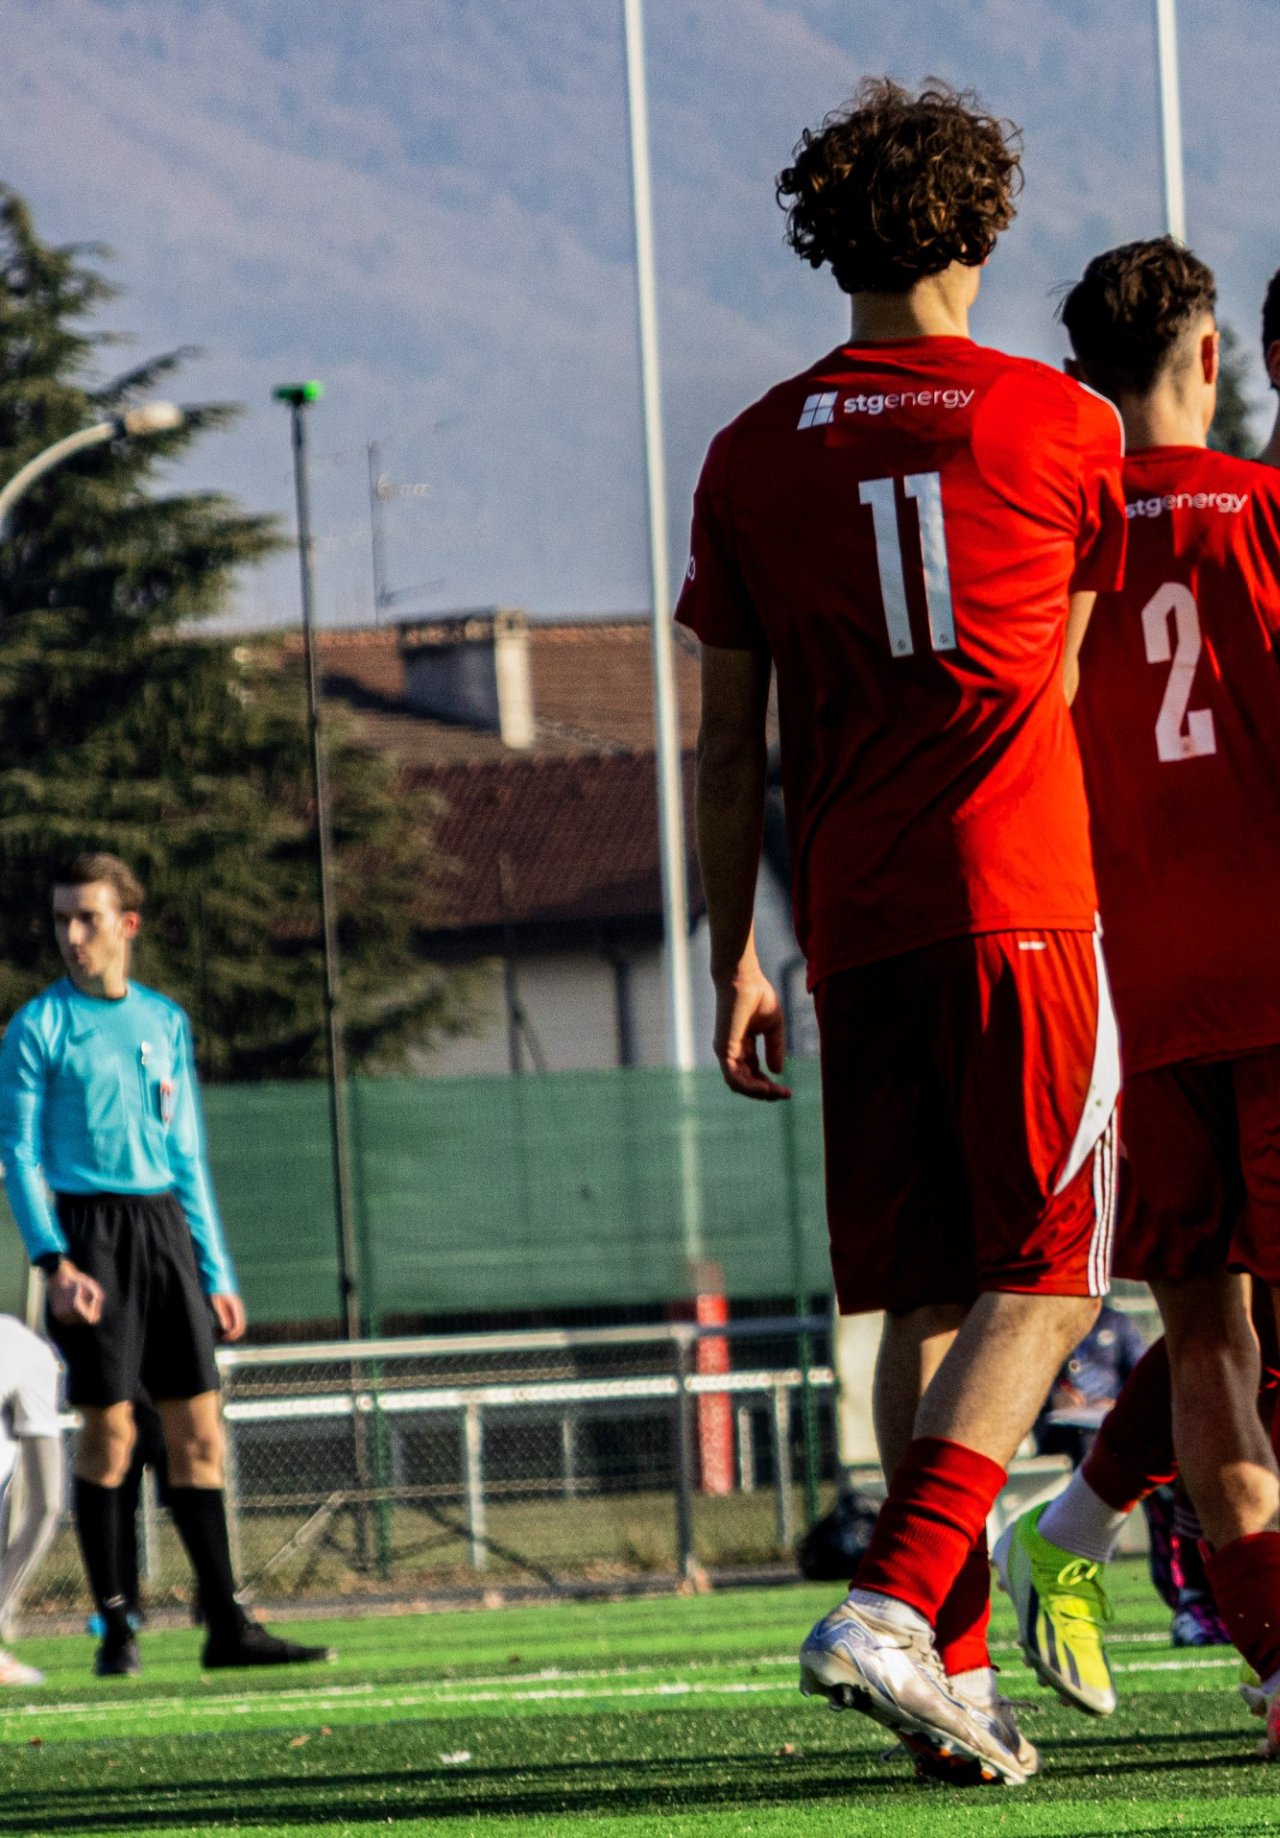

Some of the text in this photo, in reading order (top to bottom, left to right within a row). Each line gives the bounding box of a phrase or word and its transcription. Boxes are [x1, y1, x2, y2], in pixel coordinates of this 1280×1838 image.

[843, 388, 976, 415] stgenergy
[1125, 492, 1249, 518] stgenergy
[858, 471, 956, 658] 11
[1141, 581, 1217, 763] 2
